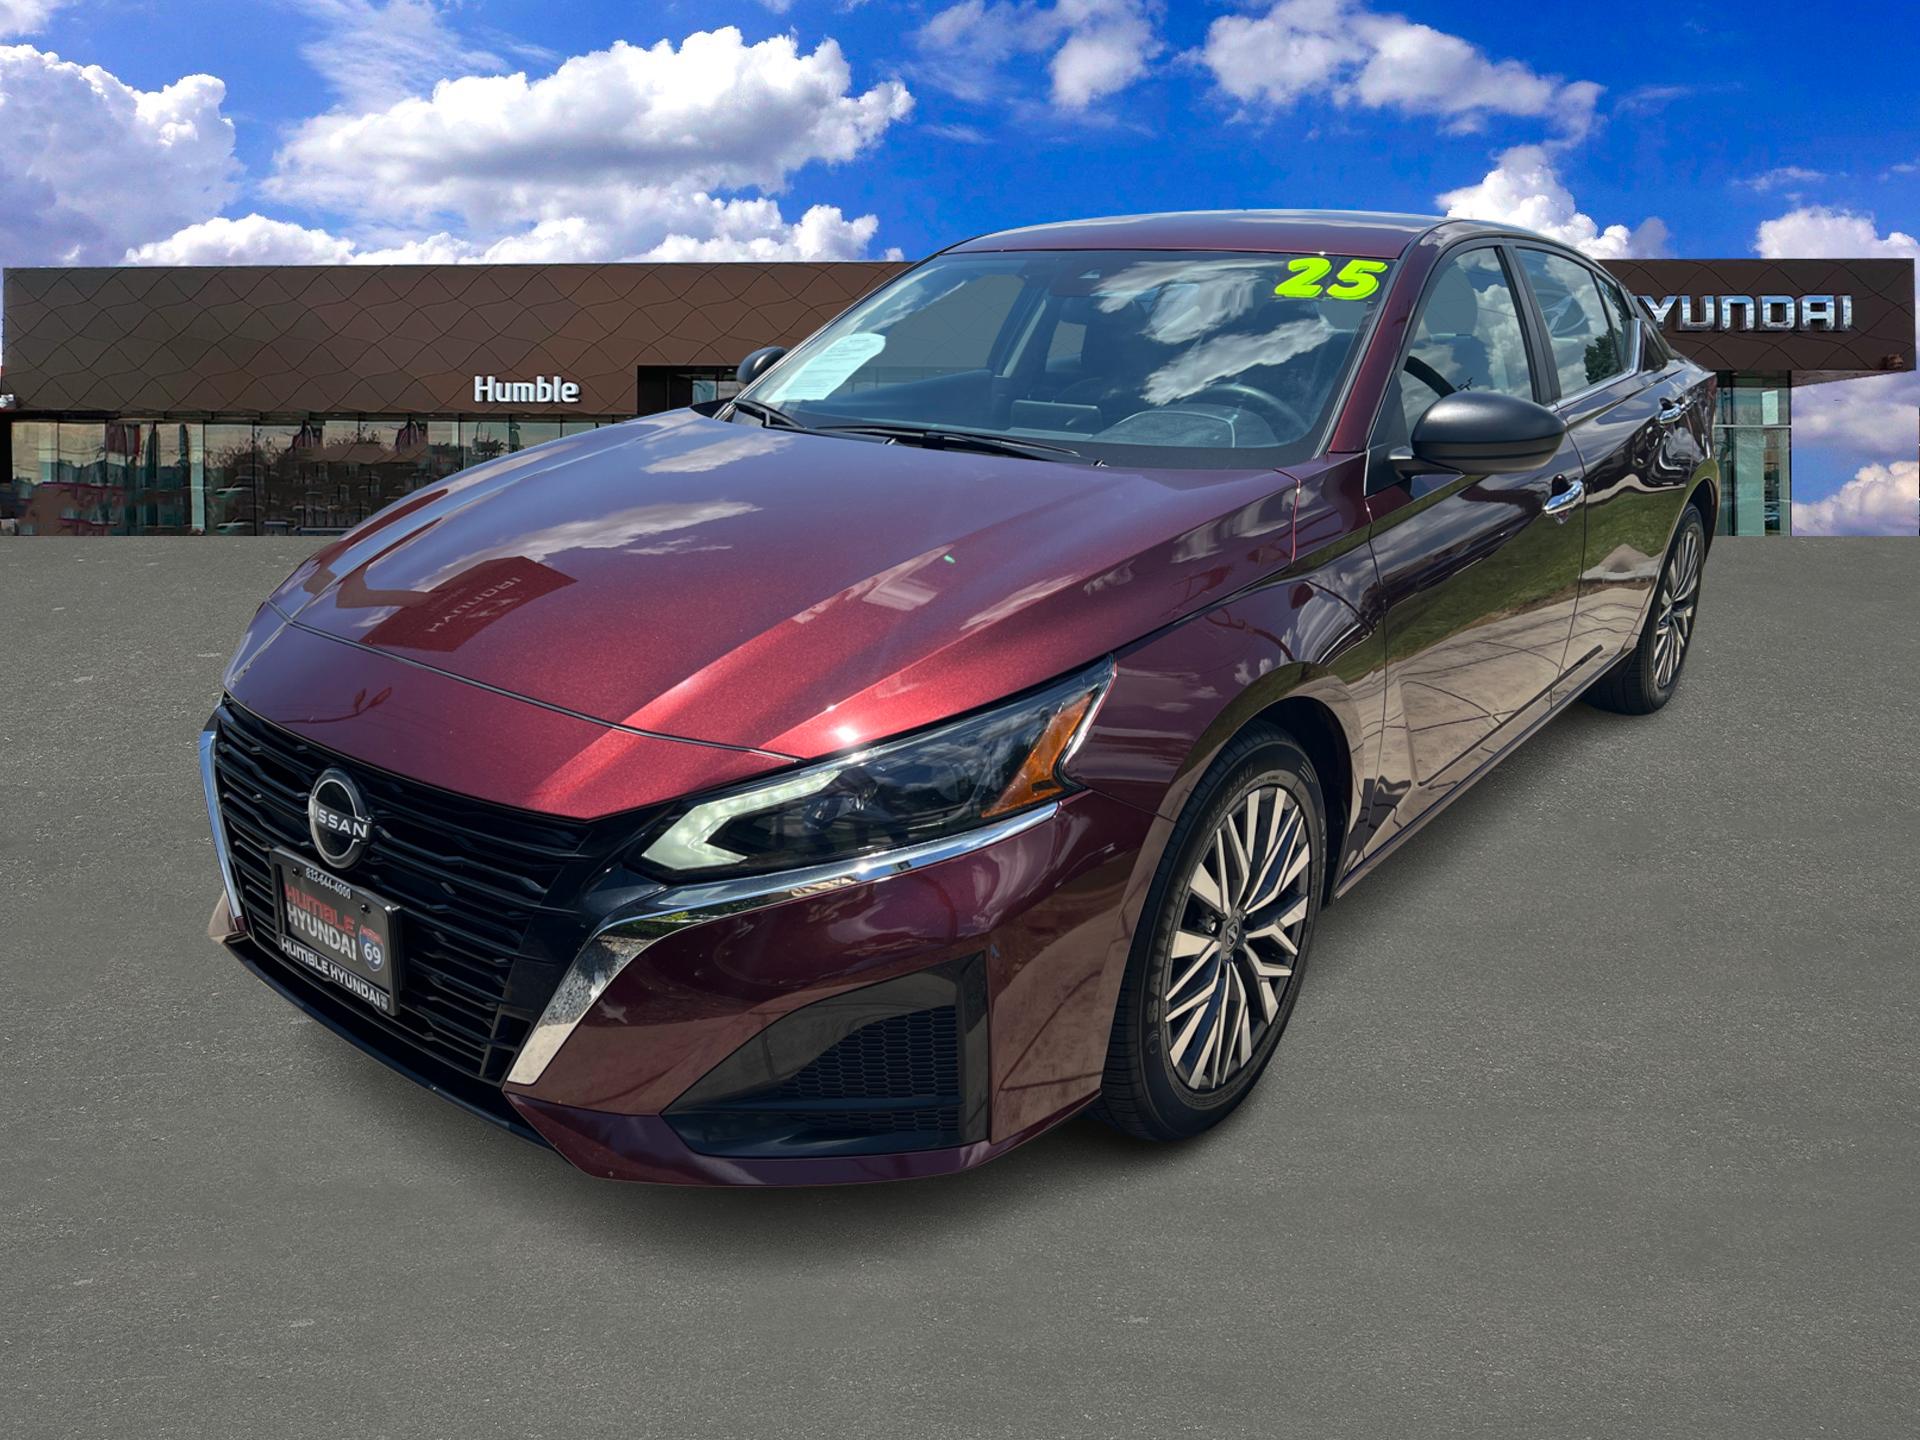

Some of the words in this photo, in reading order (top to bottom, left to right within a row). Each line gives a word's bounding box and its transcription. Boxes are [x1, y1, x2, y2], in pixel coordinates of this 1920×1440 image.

[1274, 257, 1388, 300] 25
[1635, 294, 1853, 331] YUNDAI
[474, 375, 580, 403] Humble
[284, 882, 356, 938] HUMBLE
[286, 901, 357, 961] HYUNDAI
[281, 937, 329, 975] HUMBLE
[329, 963, 381, 1007] HYUNDAI
[363, 942, 382, 965] 69
